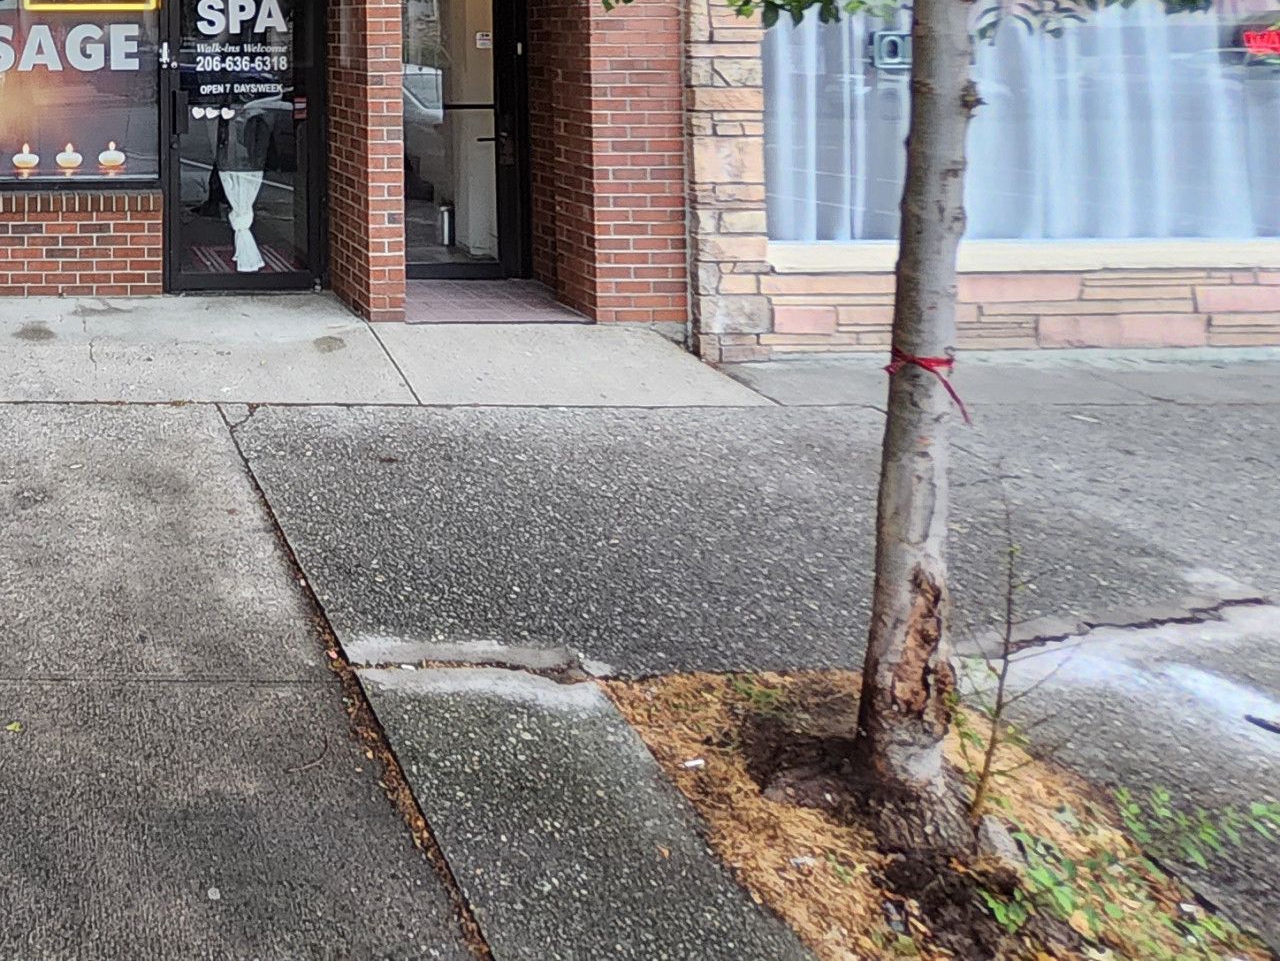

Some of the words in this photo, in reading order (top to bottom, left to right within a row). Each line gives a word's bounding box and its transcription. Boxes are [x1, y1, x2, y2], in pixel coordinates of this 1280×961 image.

[196, 43, 240, 53] Walk-ins
[244, 43, 288, 53] Welcome
[195, 56, 288, 72] 206-636-6318
[200, 85, 223, 94] OPEN
[224, 84, 231, 94] 7
[234, 83, 283, 94] DAYS/WEEK
